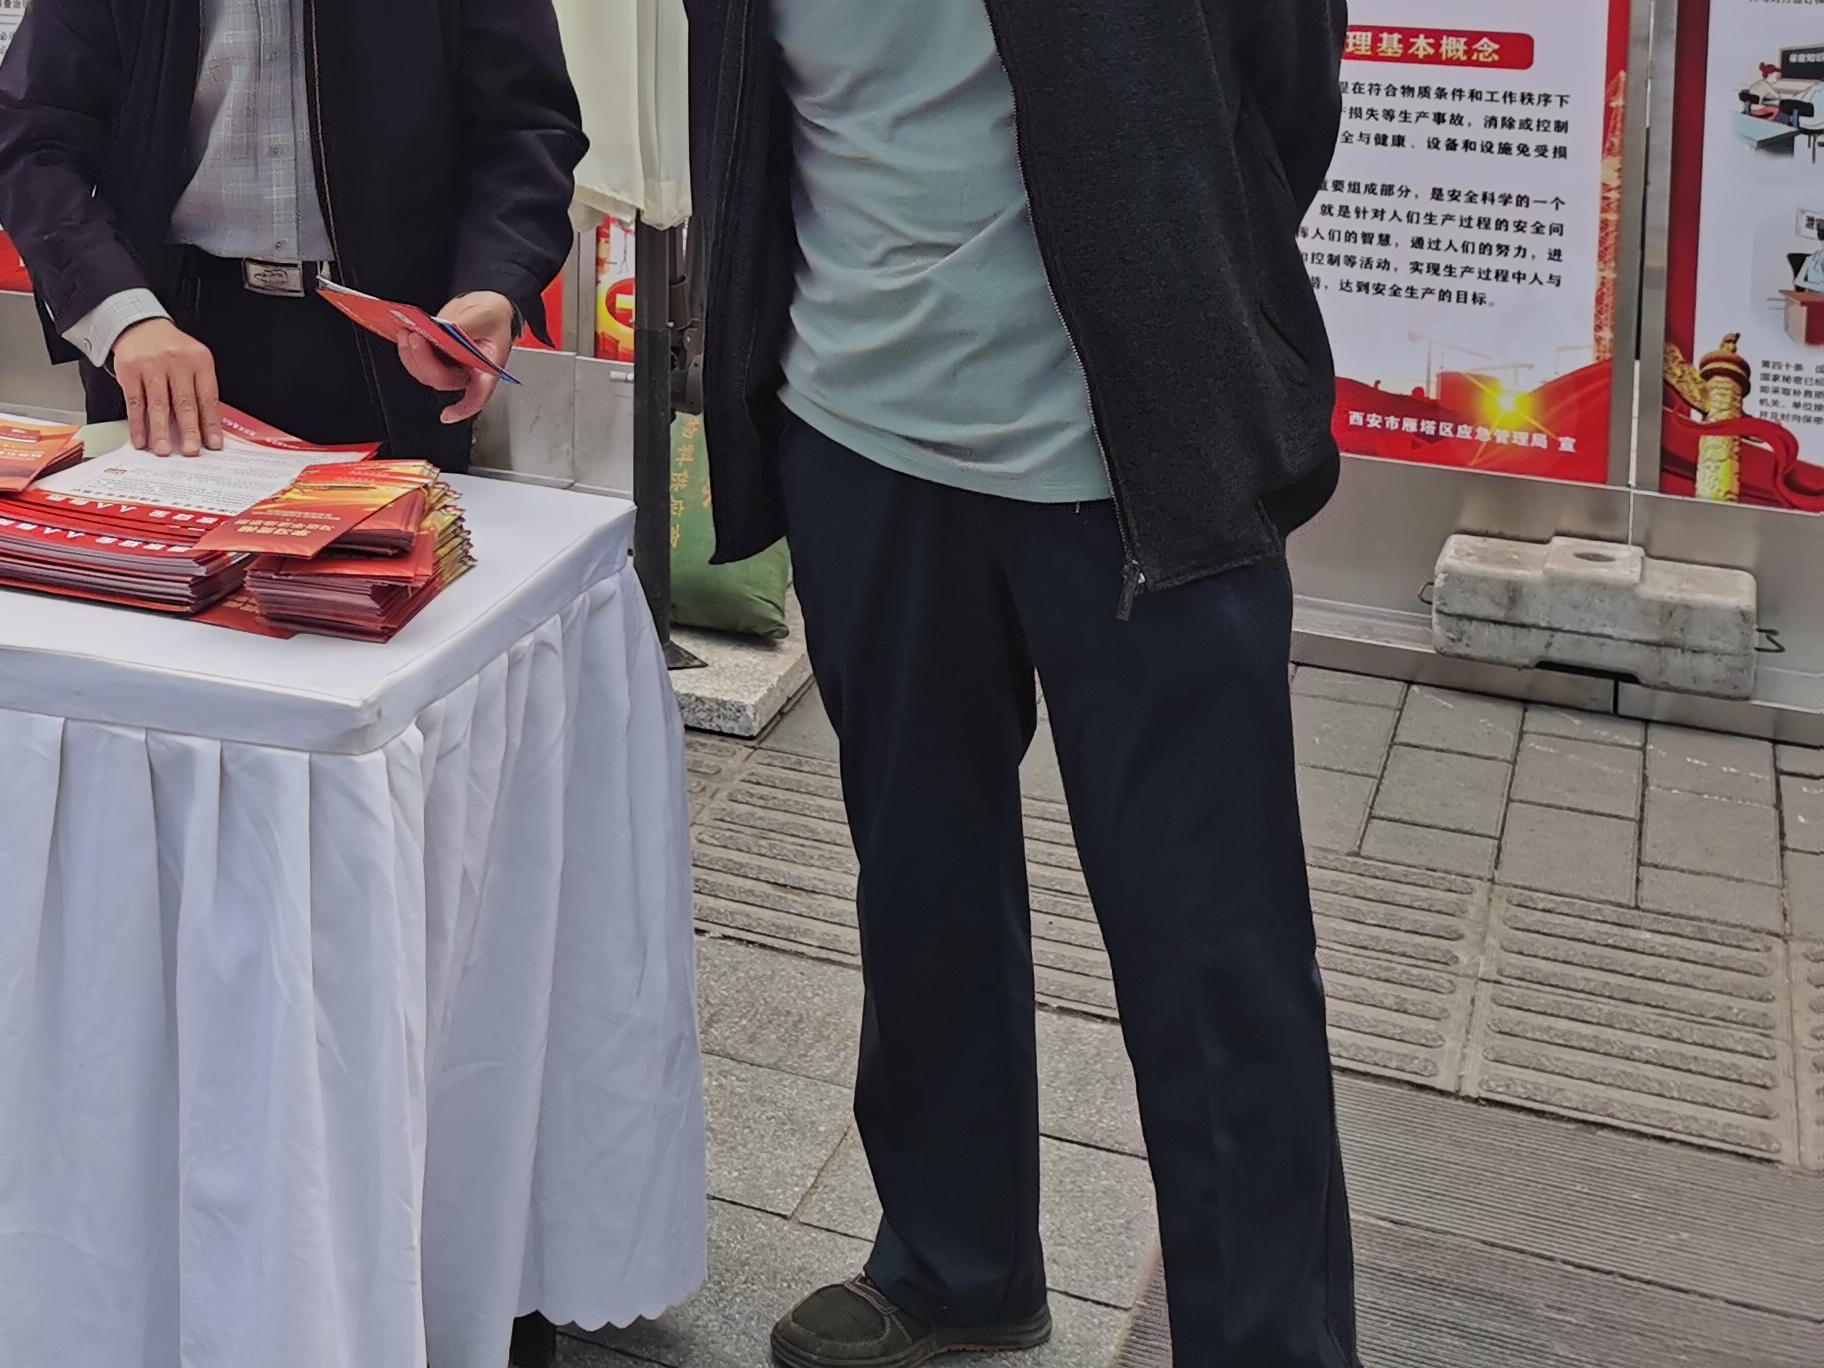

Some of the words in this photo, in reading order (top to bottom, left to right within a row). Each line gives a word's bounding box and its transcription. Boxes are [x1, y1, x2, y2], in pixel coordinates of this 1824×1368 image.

[1345, 31, 1501, 64] 理基本概念
[1341, 106, 1570, 134] 损失等生产事故,消除或控制
[1348, 409, 1549, 451] 西安市雁塔区应急管理局
[1558, 435, 1577, 453] 宣
